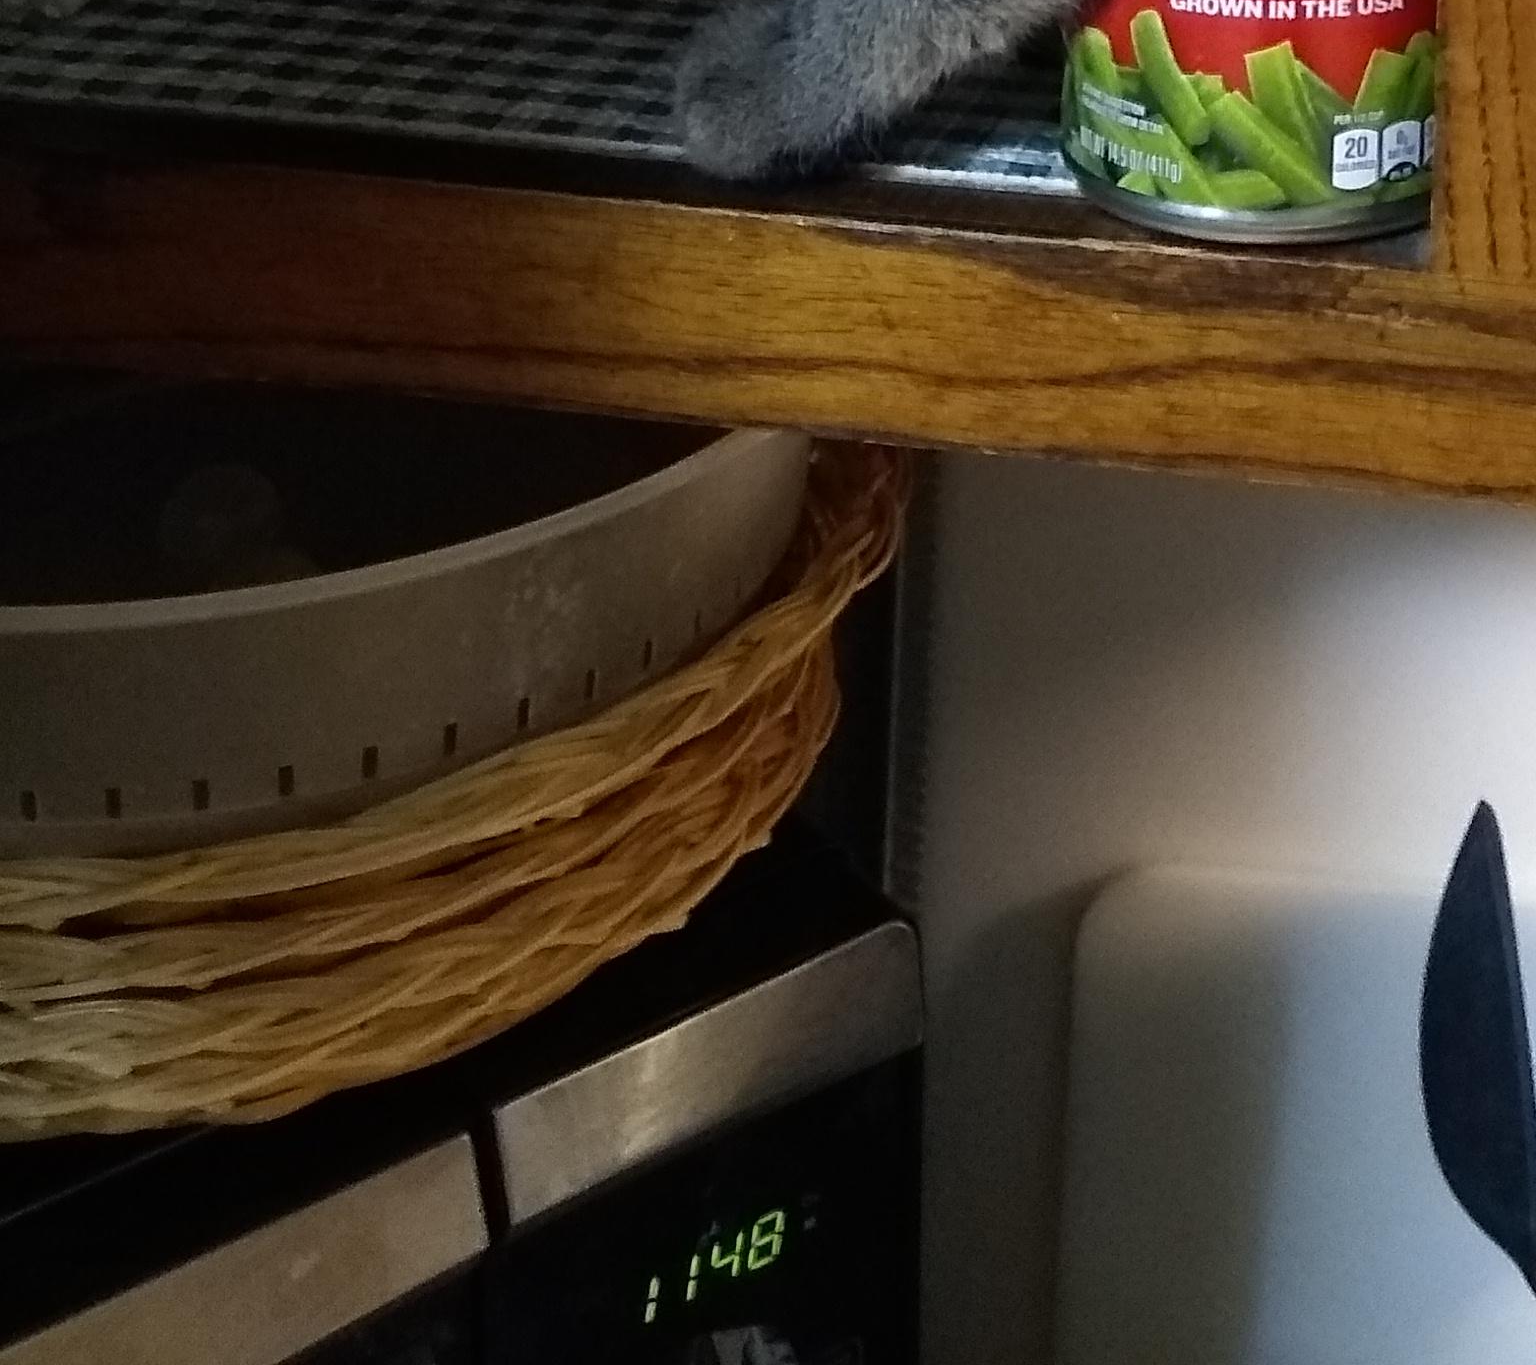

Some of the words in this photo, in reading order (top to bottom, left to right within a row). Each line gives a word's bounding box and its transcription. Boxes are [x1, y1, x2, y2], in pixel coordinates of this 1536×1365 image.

[1268, 0, 1297, 20] IN
[1107, 140, 1127, 168] 14.5
[1344, 136, 1368, 160] 20
